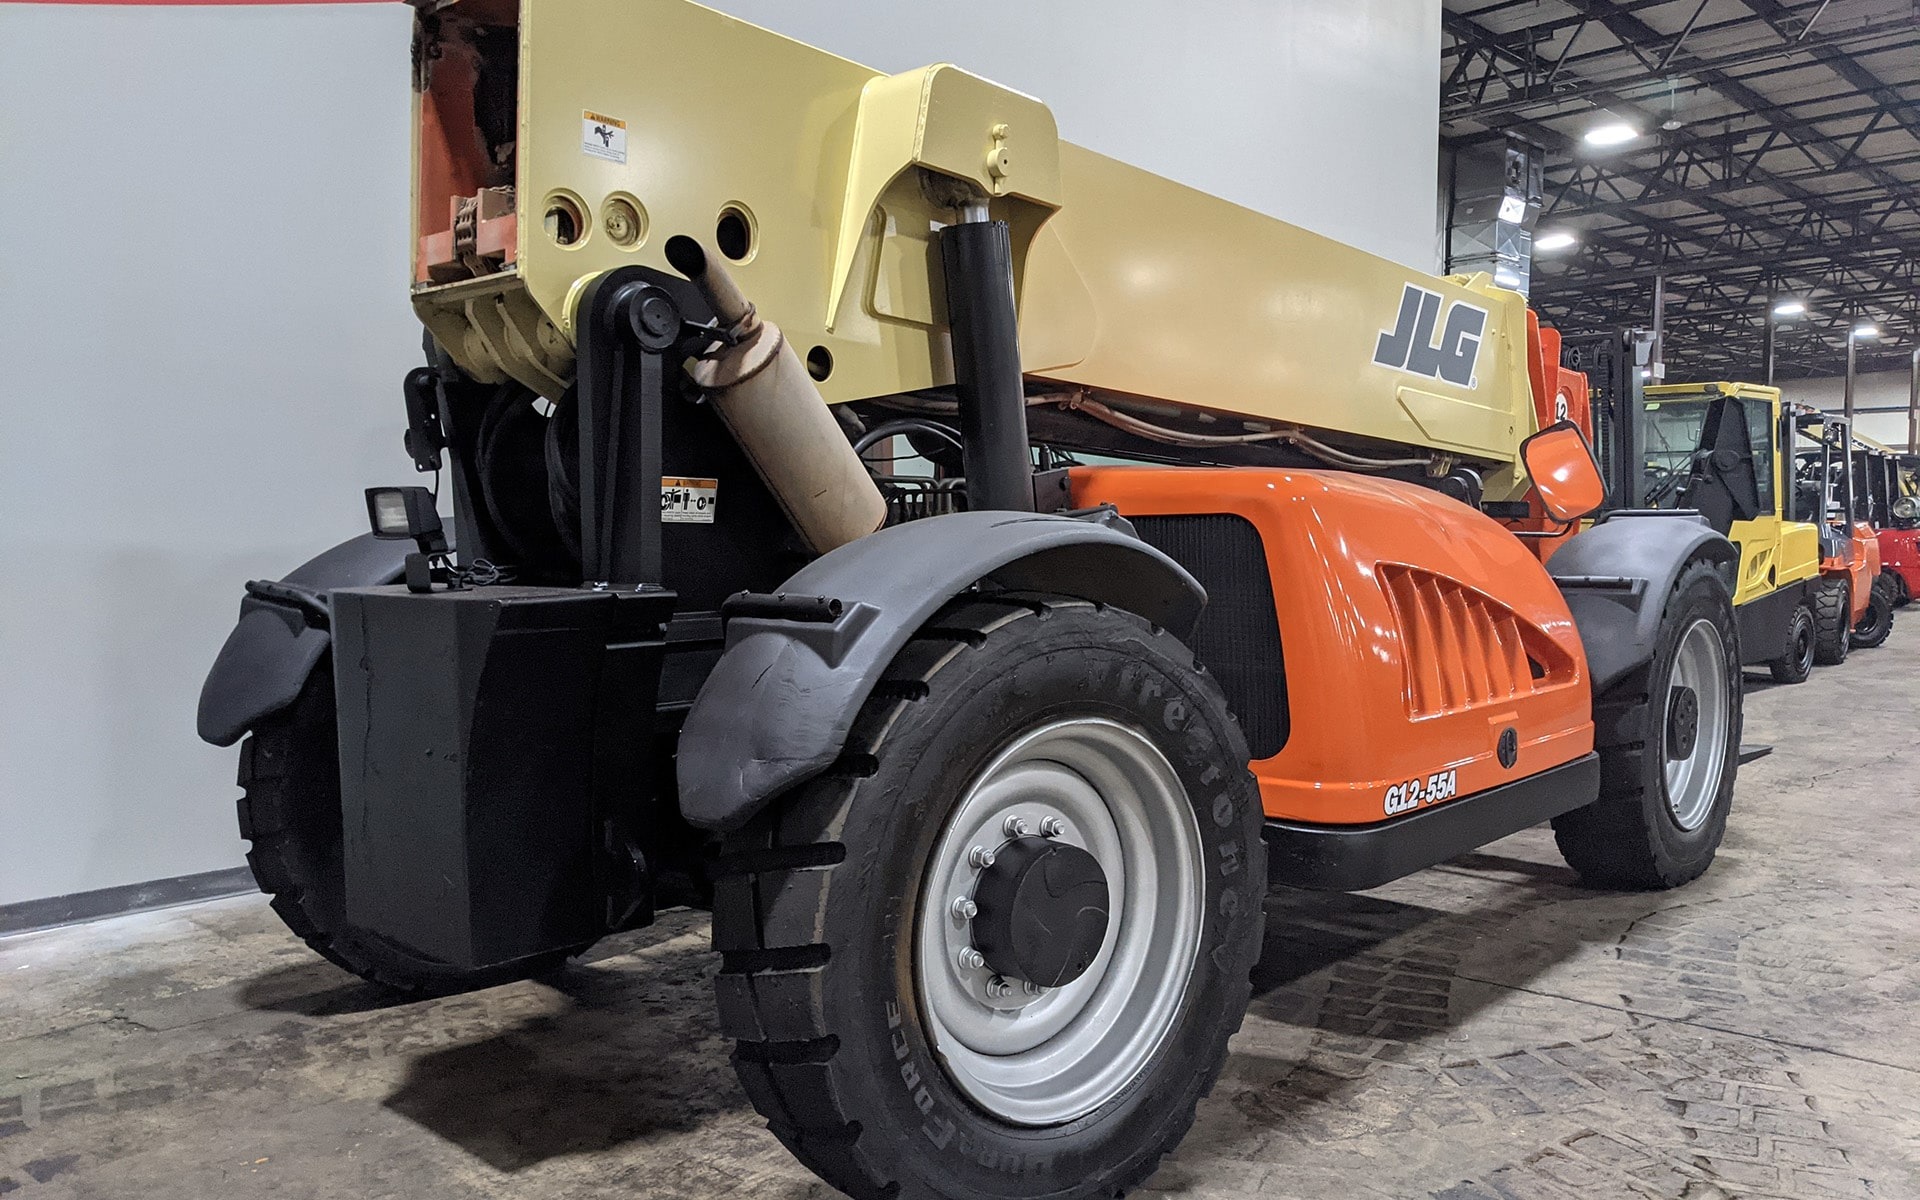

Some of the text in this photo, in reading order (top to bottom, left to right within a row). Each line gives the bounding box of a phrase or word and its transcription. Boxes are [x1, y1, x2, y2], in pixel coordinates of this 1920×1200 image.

[1372, 283, 1487, 388] JLG
[1555, 401, 1566, 420] 12
[1383, 769, 1456, 816] G12-55A
